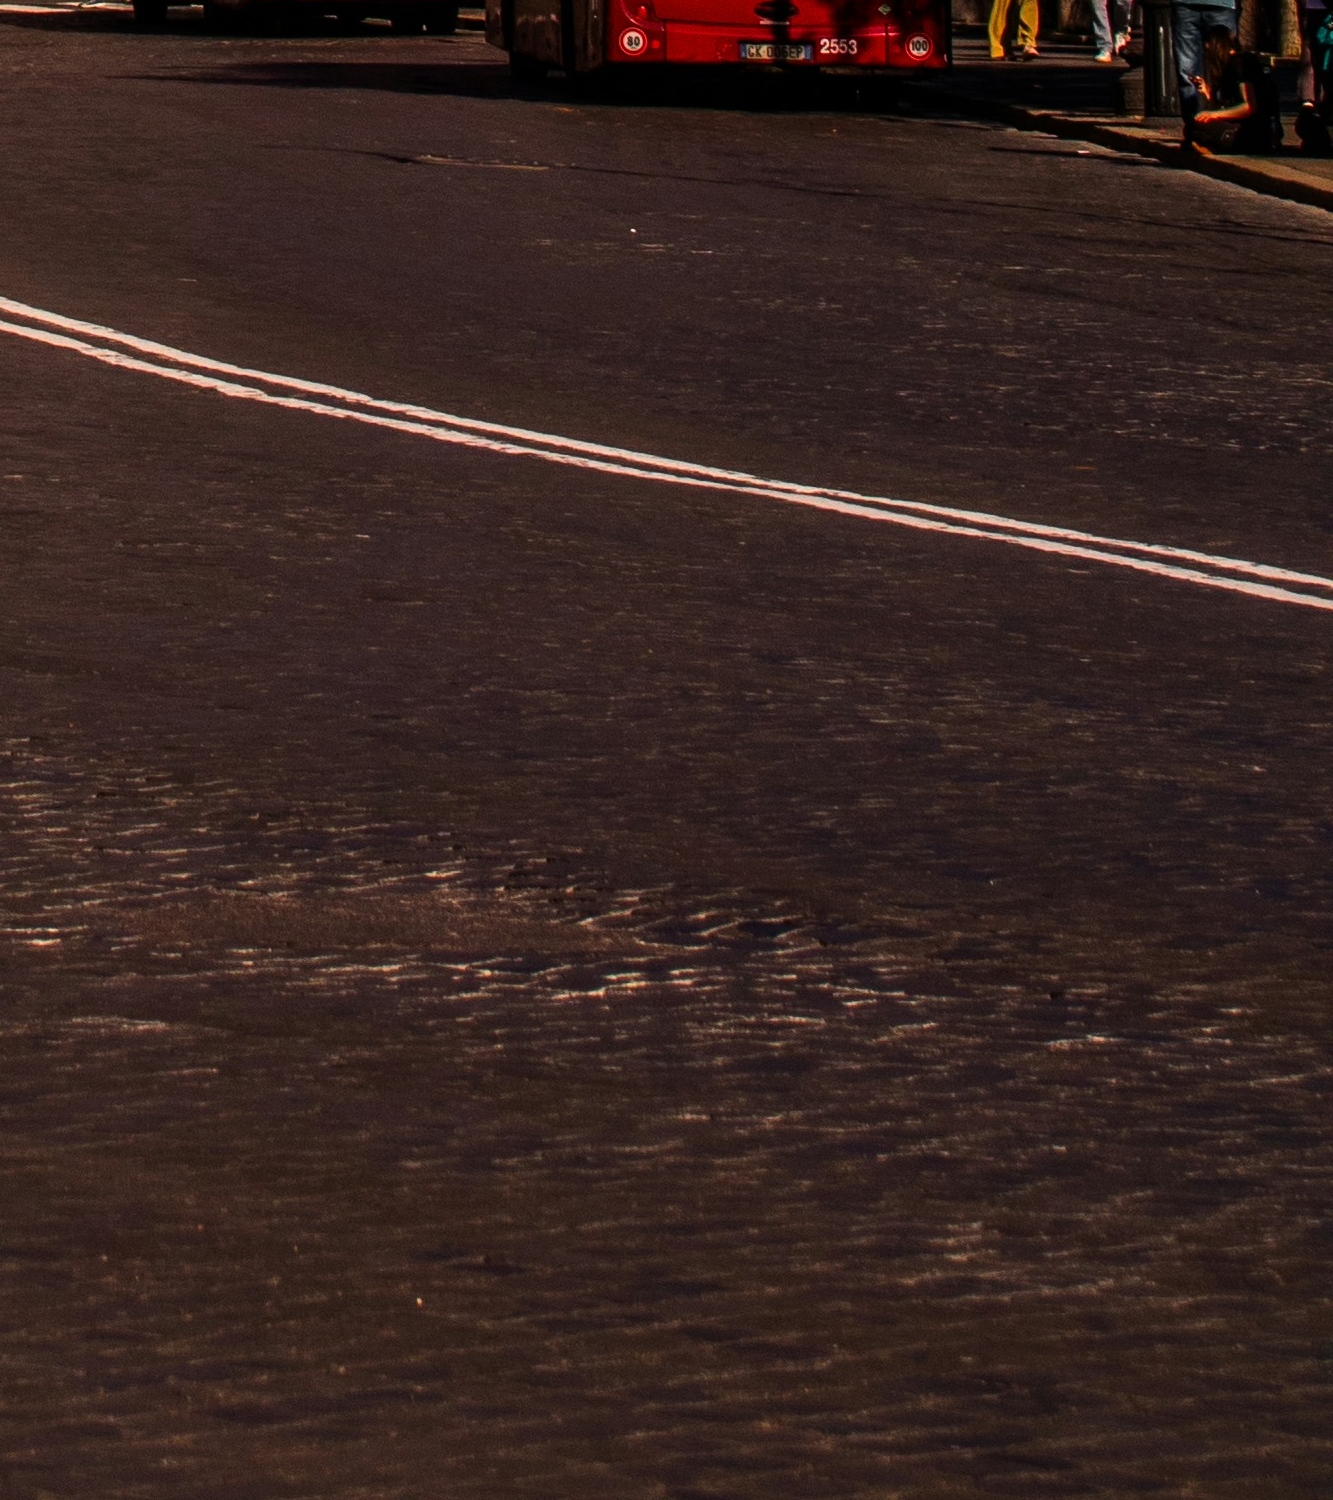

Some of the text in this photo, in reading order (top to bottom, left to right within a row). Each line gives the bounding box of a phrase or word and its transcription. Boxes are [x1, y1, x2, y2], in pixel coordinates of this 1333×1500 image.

[627, 36, 641, 48] 80
[820, 38, 857, 54] 2553
[912, 41, 928, 52] 100
